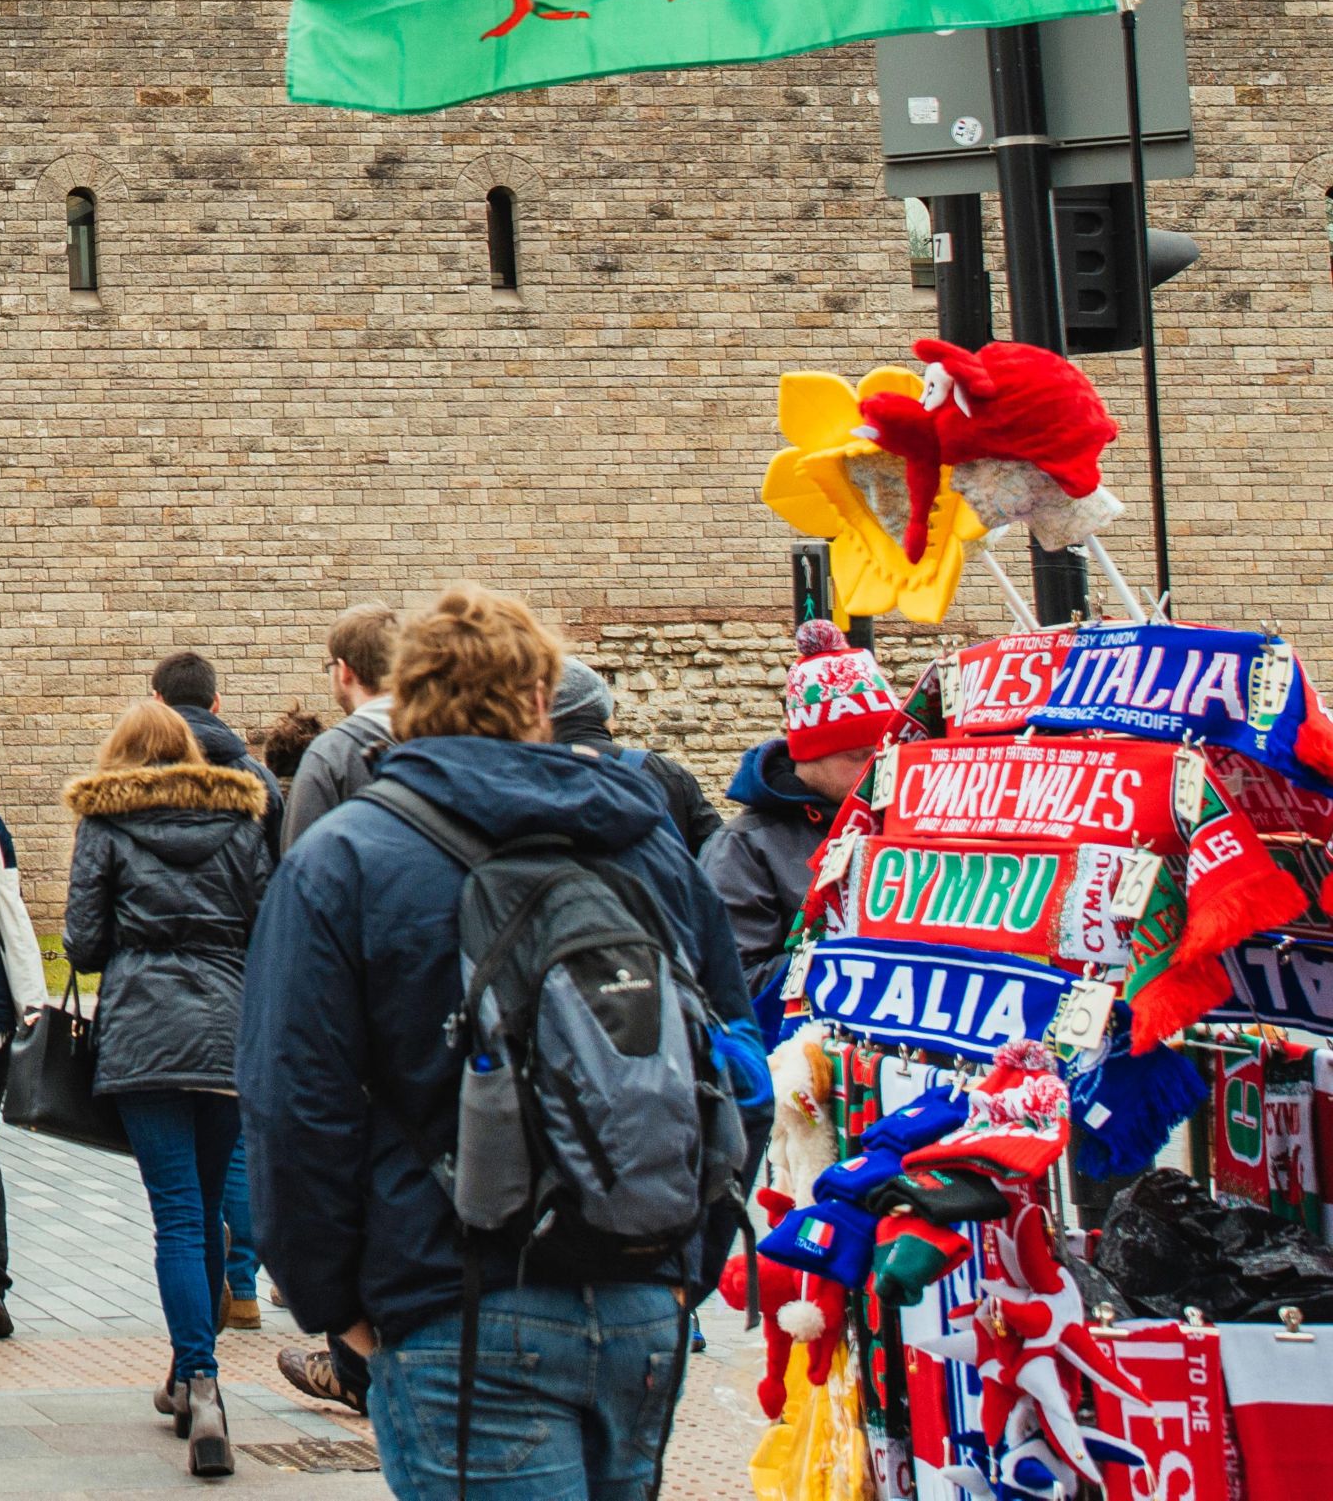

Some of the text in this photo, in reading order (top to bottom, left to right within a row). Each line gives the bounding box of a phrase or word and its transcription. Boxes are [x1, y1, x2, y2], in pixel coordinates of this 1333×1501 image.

[997, 630, 1138, 651] NATIONS RUGBY UNION
[1059, 645, 1246, 722] ITALIA
[931, 746, 1115, 767] THIS LAND OF MY FATHERS IS DEAR TO ME
[899, 762, 1142, 832] CYMRU-WALES
[865, 846, 1059, 933] CYMRU
[1083, 851, 1112, 954] CYMRU
[814, 958, 1027, 1042] ITALIA
[1188, 1353, 1208, 1385] TO
[1190, 1395, 1211, 1433] ME
